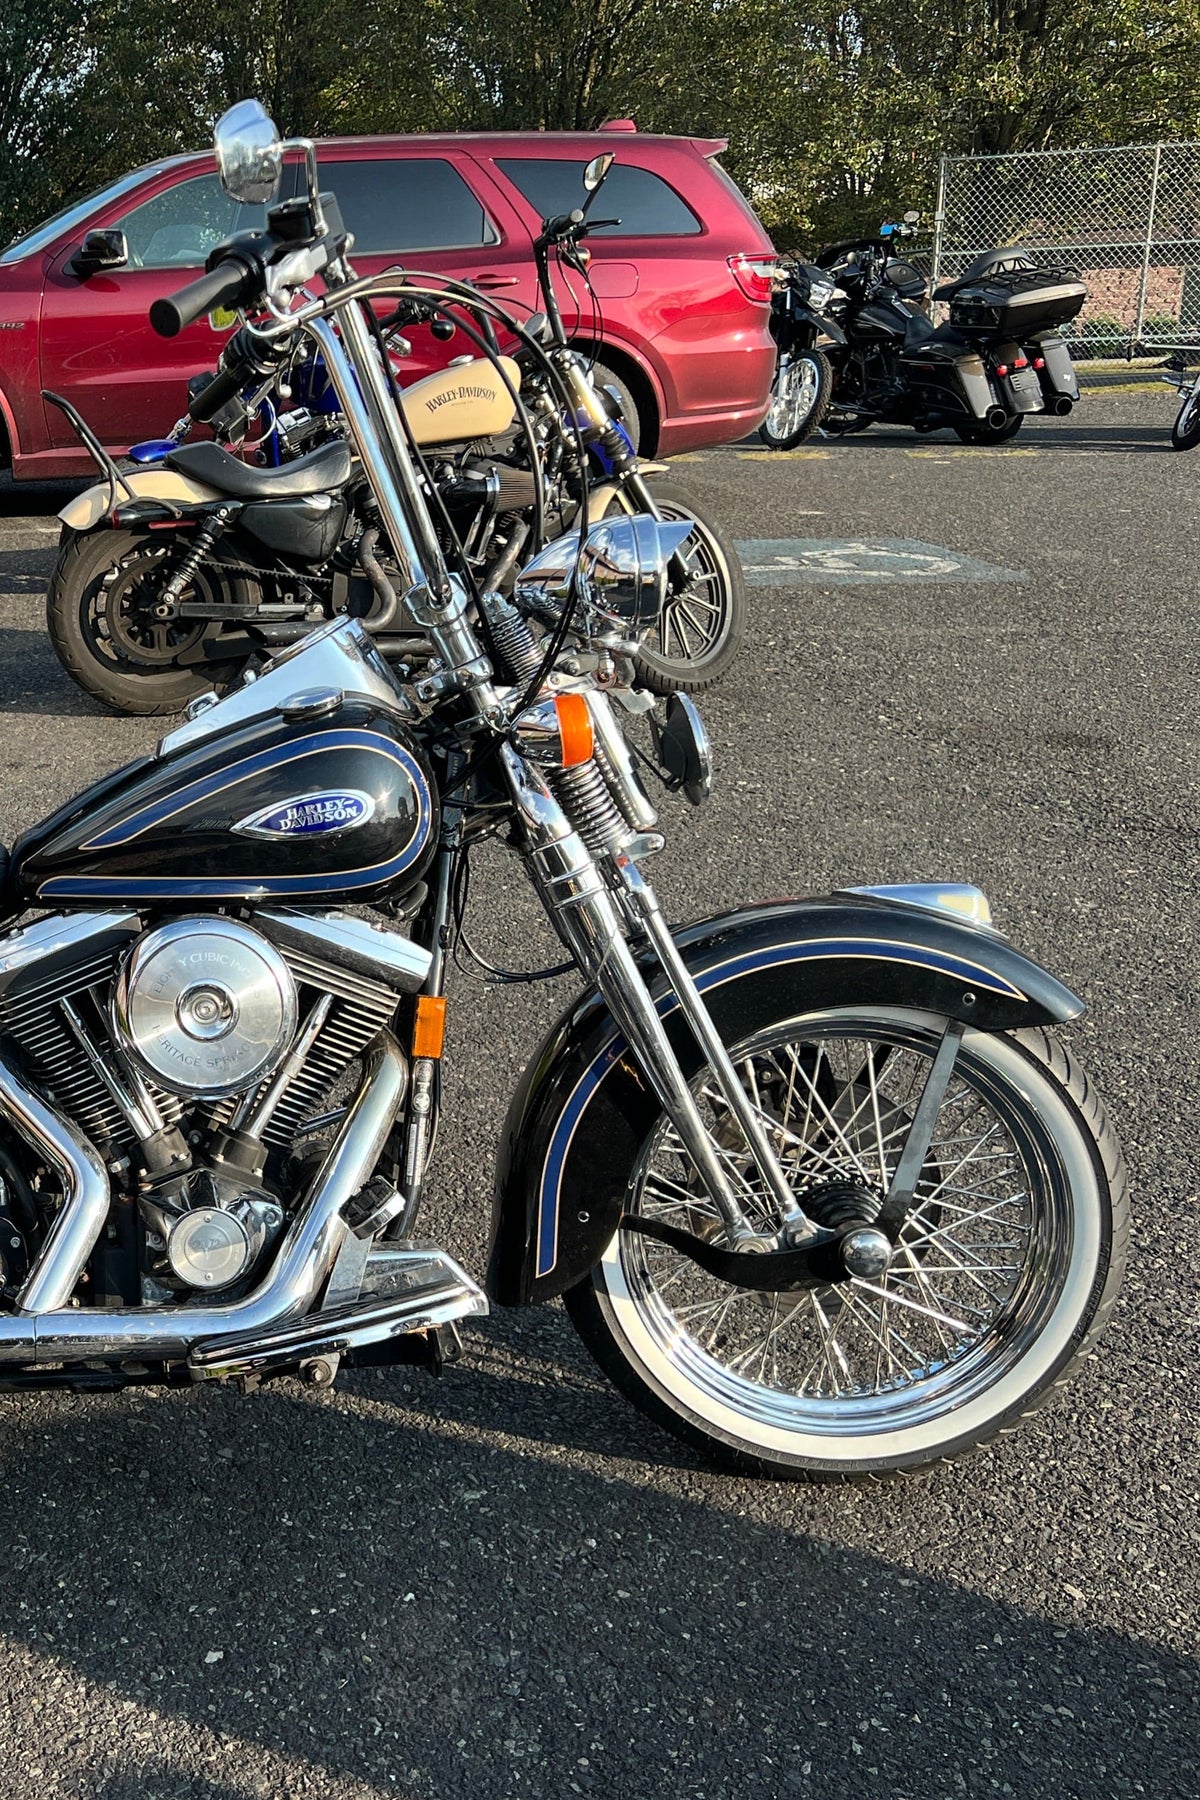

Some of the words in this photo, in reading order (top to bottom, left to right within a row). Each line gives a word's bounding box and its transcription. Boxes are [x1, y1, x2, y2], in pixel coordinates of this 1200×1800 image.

[279, 806, 359, 831] DAVIDSON
[153, 955, 187, 994] EIGHY
[190, 952, 228, 966] CUBIC
